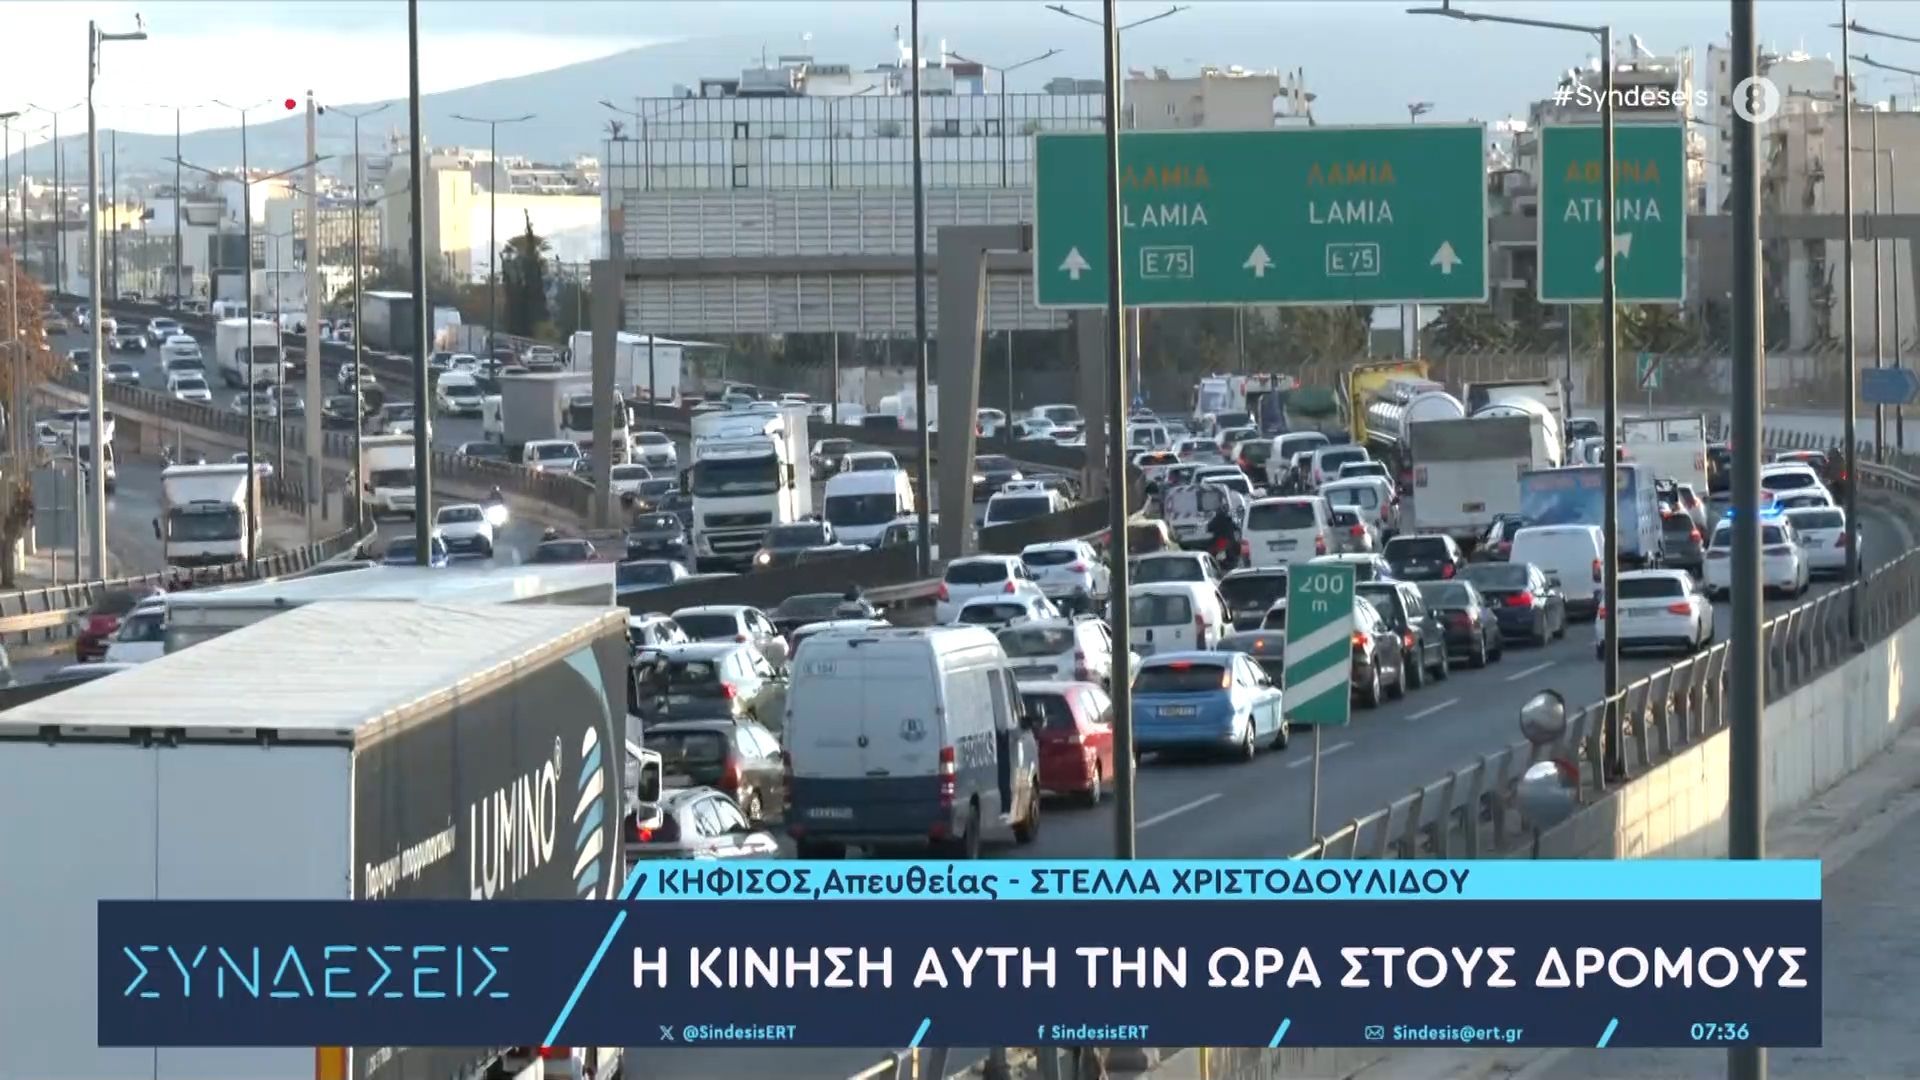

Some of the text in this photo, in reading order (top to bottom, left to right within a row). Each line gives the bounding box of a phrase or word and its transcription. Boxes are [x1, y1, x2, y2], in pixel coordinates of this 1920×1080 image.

[1307, 160, 1397, 187] ΛΑΜΙΑ
[1566, 159, 1661, 184] ΑΘΝΑ
[1123, 203, 1208, 227] LAMIA
[1309, 200, 1393, 224] LAMIA
[1146, 252, 1188, 273] E 75
[1332, 249, 1374, 271] E 75
[1299, 573, 1344, 595] 200
[1312, 599, 1328, 612] m
